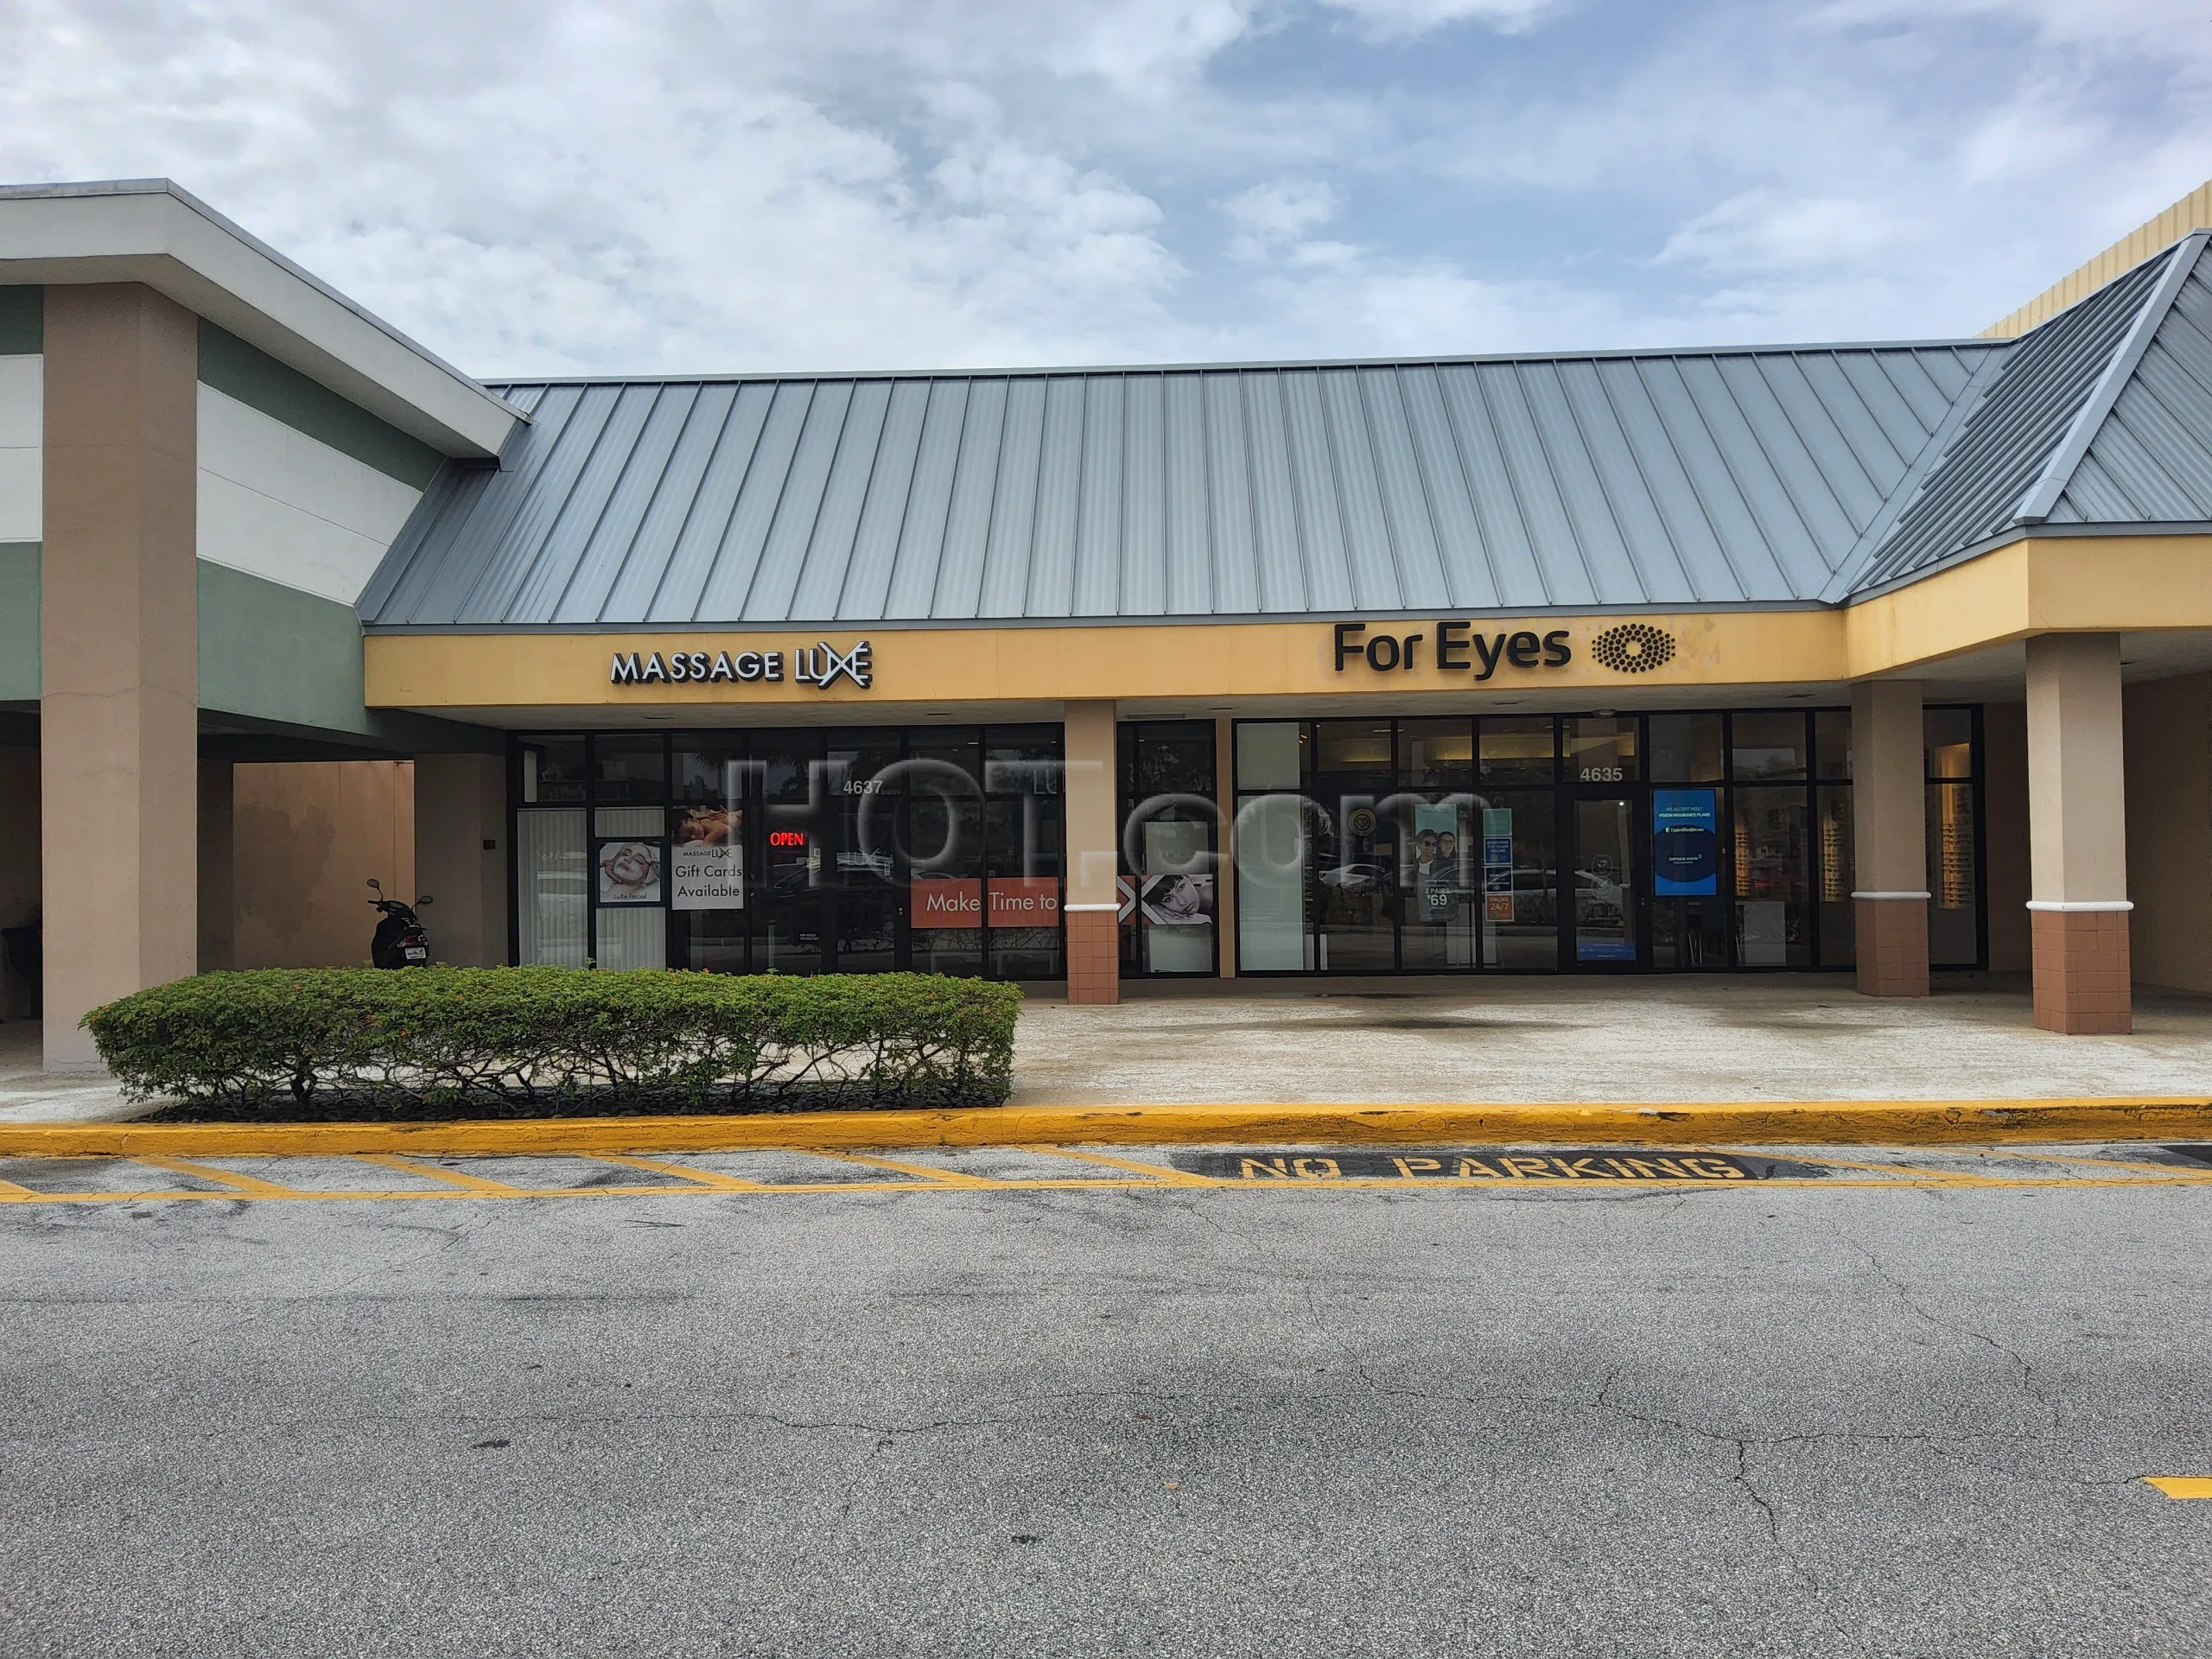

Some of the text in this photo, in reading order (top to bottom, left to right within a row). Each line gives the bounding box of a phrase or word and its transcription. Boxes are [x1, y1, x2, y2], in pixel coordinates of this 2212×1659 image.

[1333, 621, 1572, 682] For Eyes
[609, 640, 872, 690] MASSAGE LUXE
[1580, 766, 1623, 782] 4635
[842, 779, 883, 795] 4637
[770, 832, 804, 846] OPEN
[675, 863, 742, 878] Gift Cards
[677, 884, 740, 898] Available
[925, 891, 1058, 912] Make Time to
[1490, 902, 1509, 911] 24/7
[1239, 1156, 1747, 1179] NO PARKING
